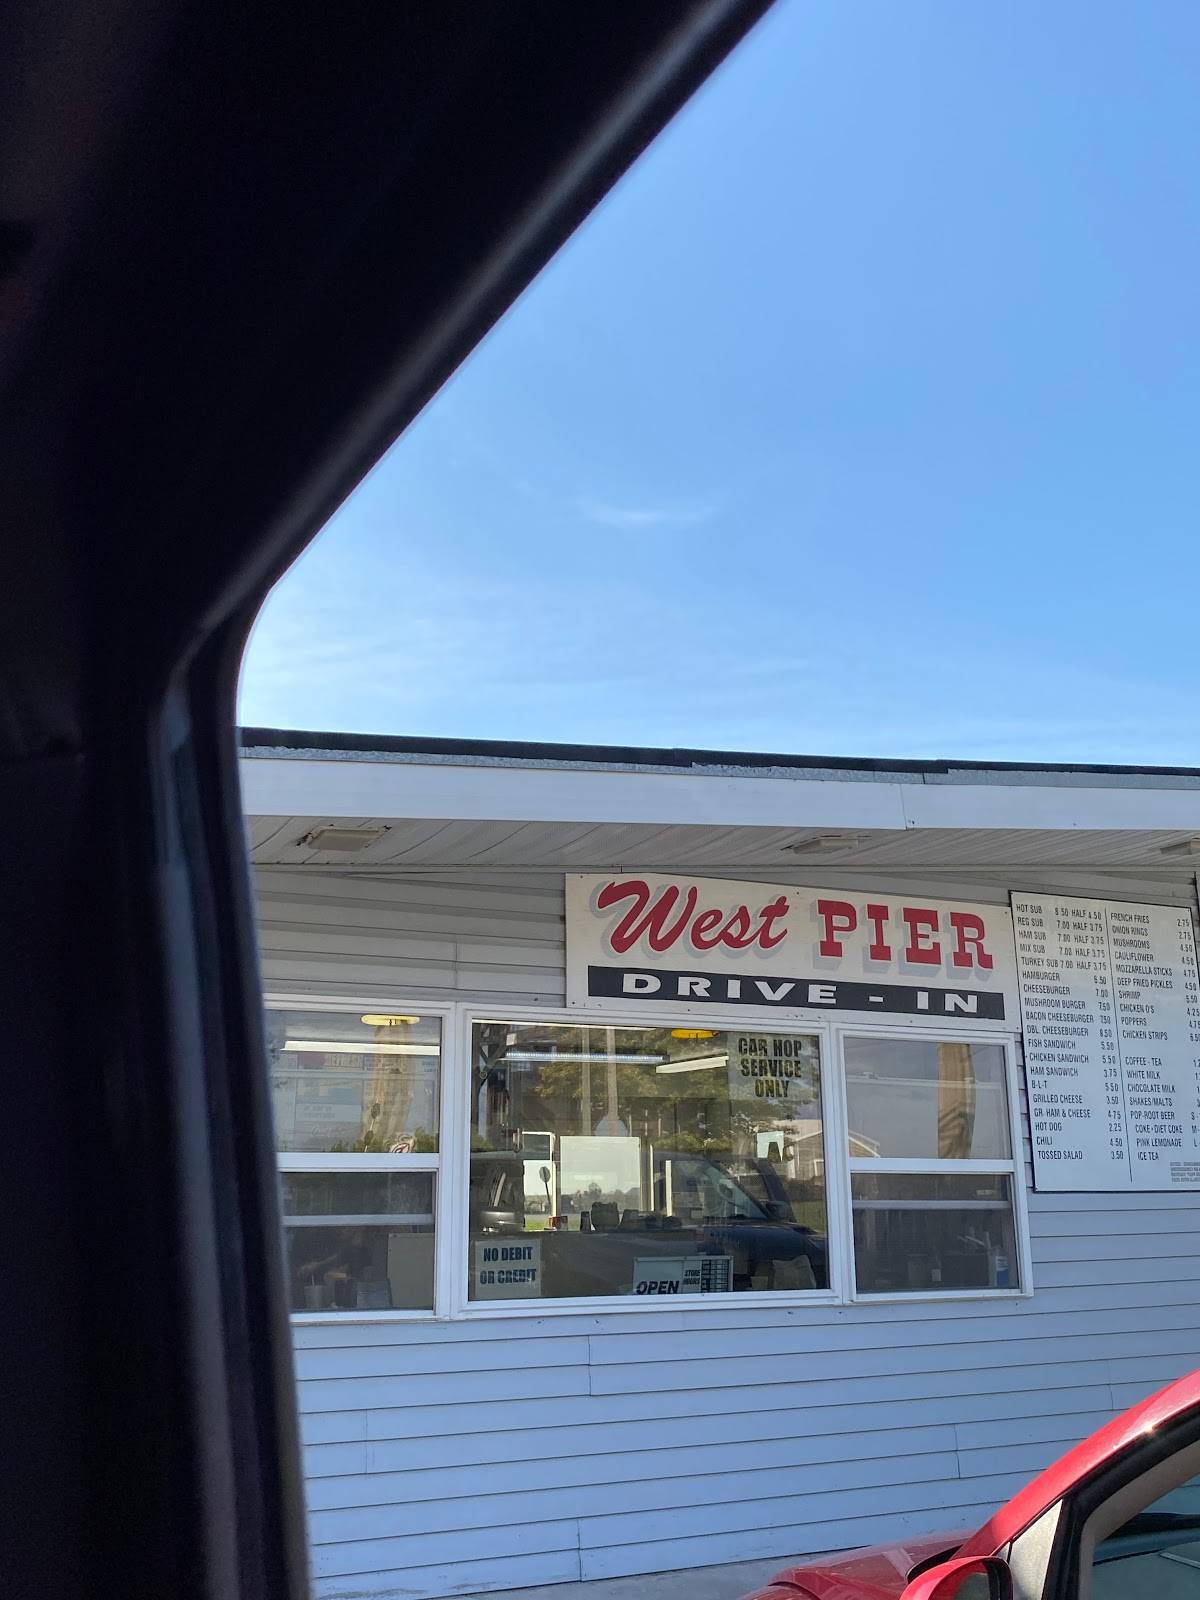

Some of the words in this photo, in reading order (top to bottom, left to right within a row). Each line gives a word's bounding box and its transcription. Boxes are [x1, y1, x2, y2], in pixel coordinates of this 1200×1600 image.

[1016, 904, 1028, 913] HOT
[1030, 905, 1042, 914] SUB
[1072, 909, 1086, 918] HALF
[1110, 912, 1133, 922] FRENCH
[1134, 914, 1150, 924] FRIES
[598, 880, 790, 954] West
[818, 899, 993, 970] PIER
[1017, 917, 1030, 926] REG
[1031, 918, 1044, 927] SUB
[1073, 921, 1087, 931] HALF
[1112, 925, 1130, 935] ONION
[1131, 926, 1149, 936] RINGS
[1019, 930, 1033, 939] HAM
[1033, 931, 1047, 940] SUB
[1074, 935, 1089, 944] HALF
[1113, 938, 1150, 949] MUSHROOMS
[1020, 943, 1032, 953] MIX
[1033, 944, 1045, 954] SUB
[1075, 948, 1090, 957] HALF
[1114, 951, 1154, 962] CAULIFLOWER
[1021, 956, 1045, 966] TURKEY
[1046, 958, 1059, 968] SUB
[1077, 961, 1091, 970] HALF
[1022, 970, 1060, 981] HAMBURGER
[1116, 964, 1153, 975] MOZZARELLA
[1153, 967, 1173, 976] STICKS
[1117, 977, 1132, 986] DEEP
[1133, 978, 1150, 988] FRIED
[1150, 979, 1173, 989] PICKLES
[622, 973, 837, 1005] DRIVE
[916, 992, 978, 1013] IN
[1023, 984, 1071, 995] CHEESEBURGER
[1118, 990, 1140, 1000] SHRIMP
[1024, 997, 1061, 1008] MUSHROOM
[1062, 1000, 1086, 1010] BURGER
[1119, 1003, 1144, 1013] CHICKEN
[1025, 1011, 1046, 1020] BACON
[1048, 1012, 1094, 1023] CHEESEBURGER
[1121, 1016, 1147, 1026] POPPERS
[1042, 1025, 1089, 1036] CHEESEBURGER
[1122, 1029, 1147, 1039] CHICKEN
[1148, 1031, 1168, 1041] STRIPS
[738, 1038, 767, 1056] CAR
[773, 1039, 802, 1057] HOP
[1028, 1039, 1042, 1048] FISH
[1043, 1039, 1076, 1049] SANDWICH
[1029, 1052, 1056, 1062] CHICKEN
[1057, 1053, 1089, 1063] SANDWICH
[1125, 1056, 1147, 1066] COFFEE
[1151, 1057, 1162, 1067] TEA
[741, 1058, 802, 1078] SERVICE
[1030, 1066, 1044, 1076] HAM
[1046, 1067, 1079, 1077] SANDWICH
[1126, 1070, 1145, 1079] WHITE
[1146, 1070, 1160, 1079] MILK
[755, 1079, 789, 1098] ONLY
[1127, 1083, 1160, 1093] CHOCOLATE
[1161, 1084, 1176, 1093] MILK
[1032, 1094, 1059, 1103] GRILLED
[1060, 1094, 1083, 1104] CHEESE
[1046, 1108, 1060, 1118] HAM
[1062, 1109, 1066, 1118] &
[1067, 1109, 1091, 1118] CHEESE
[1161, 1111, 1175, 1120] BEER
[1035, 1122, 1048, 1131] HOT
[1049, 1122, 1062, 1131] DOG
[1135, 1124, 1150, 1133] COKE
[1154, 1124, 1167, 1133] DIET
[1168, 1124, 1183, 1134] COKE
[1036, 1136, 1053, 1146] CHILI
[1136, 1138, 1150, 1147] PINK
[1151, 1138, 1182, 1147] LEMONADE
[1037, 1150, 1062, 1160] TOSSED
[1063, 1150, 1083, 1160] SALAD
[1137, 1152, 1147, 1160] ICE
[1148, 1152, 1160, 1160] TEA
[483, 1248, 499, 1262] NO
[501, 1247, 533, 1261] DEBIT
[480, 1270, 495, 1284] OR
[498, 1269, 536, 1284] CREDIT
[636, 1280, 680, 1295] OPEN
